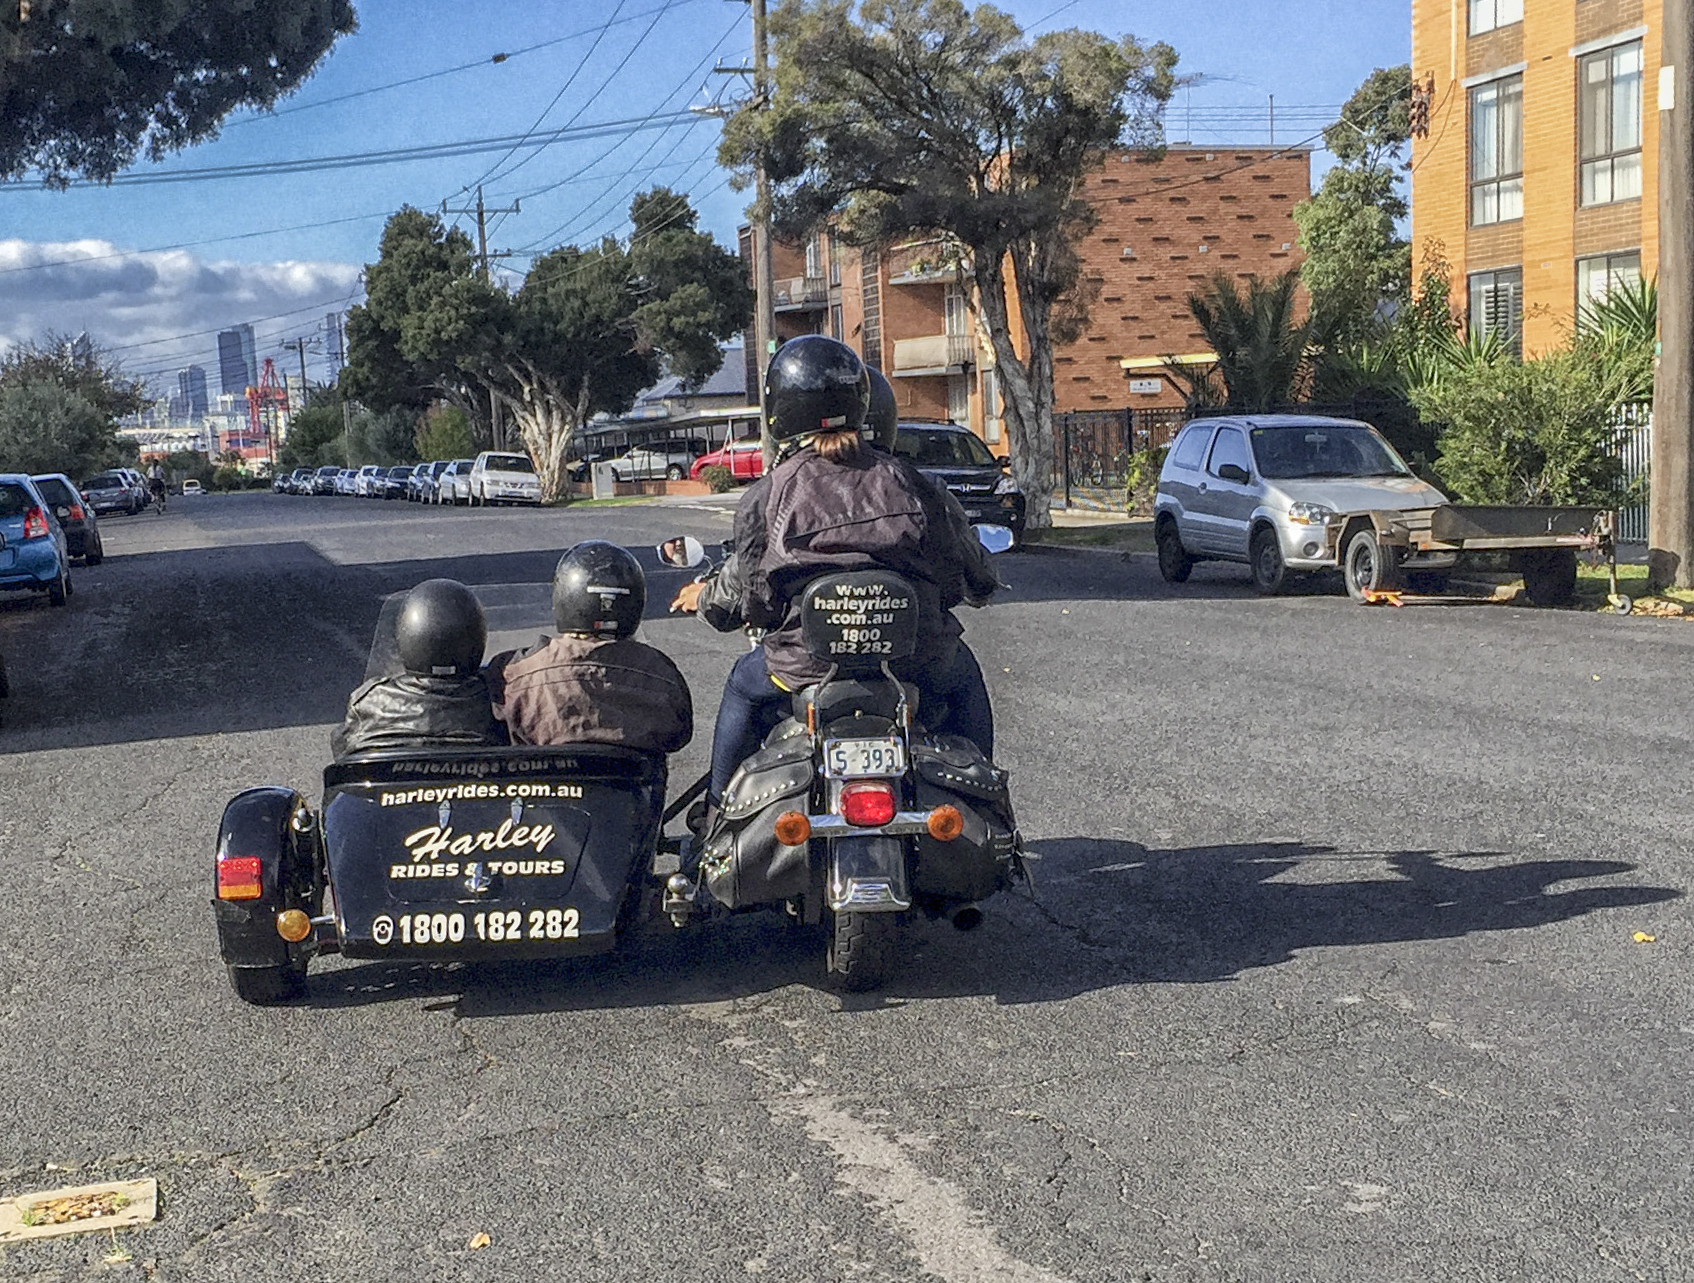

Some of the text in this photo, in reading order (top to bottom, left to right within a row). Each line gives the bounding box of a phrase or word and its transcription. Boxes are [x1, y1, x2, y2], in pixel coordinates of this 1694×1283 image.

[814, 596, 908, 614] harleyrides
[826, 612, 894, 625] .com.au
[842, 628, 881, 642] 1800
[829, 641, 892, 655] 182 282
[381, 784, 583, 806] harleyrides.com.au
[404, 818, 555, 863] Harley
[390, 862, 459, 879] RIDES
[488, 860, 565, 875] TOURS
[400, 908, 580, 944] 1800 182 282
